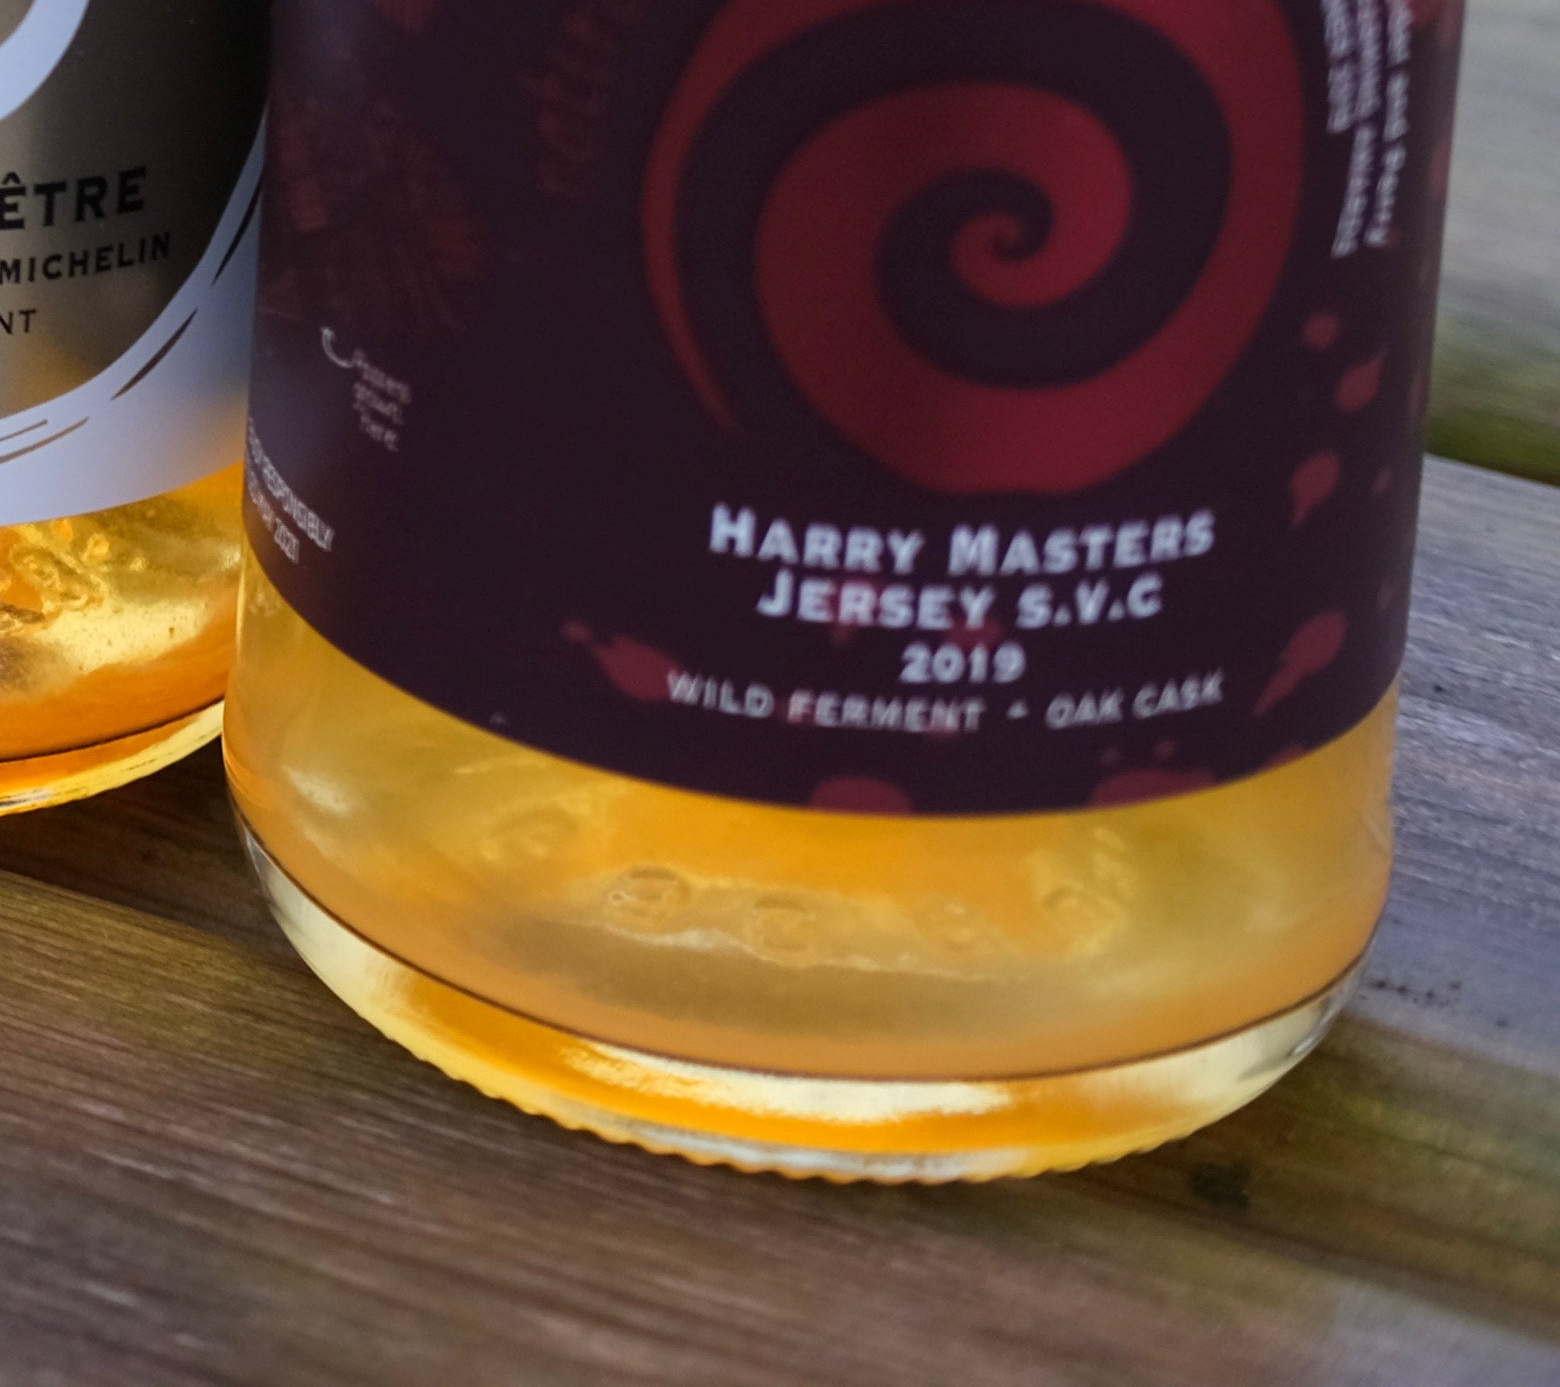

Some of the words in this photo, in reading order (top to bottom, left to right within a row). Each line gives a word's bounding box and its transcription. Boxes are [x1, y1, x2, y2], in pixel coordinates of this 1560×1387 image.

[710, 502, 922, 575] HARRY
[949, 508, 1214, 576] MASTERS
[757, 568, 994, 628] JERSEY
[898, 641, 1026, 684] 2019
[667, 671, 774, 718] WILD
[787, 689, 985, 733] FERMENT
[1046, 691, 1122, 728] OAK
[1133, 668, 1224, 719] CASK
